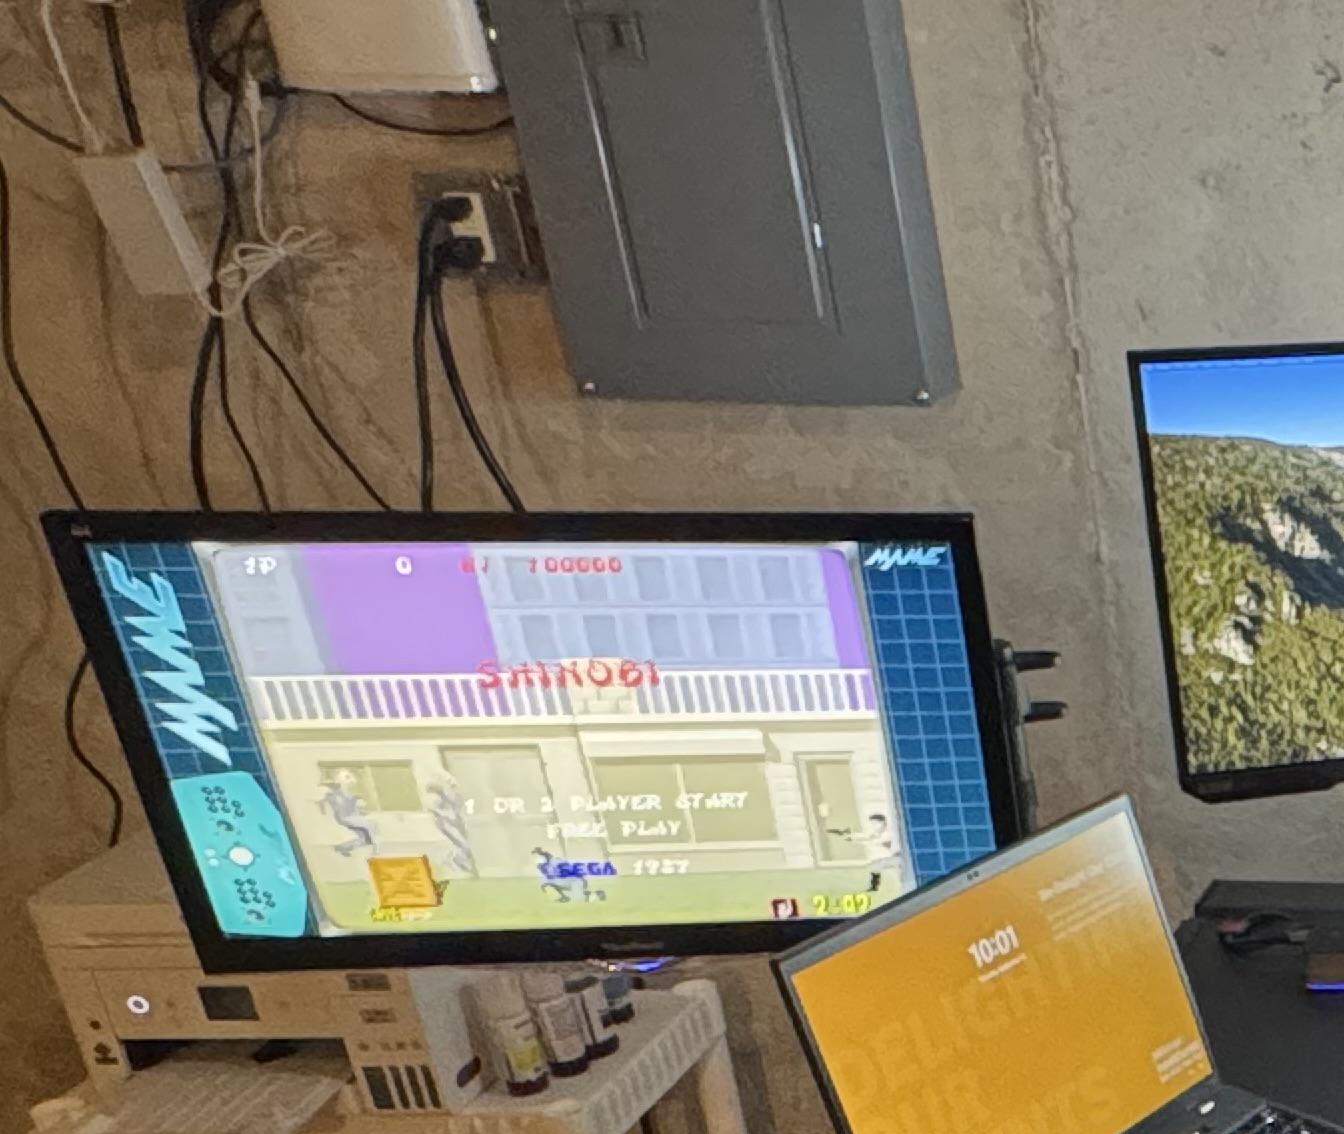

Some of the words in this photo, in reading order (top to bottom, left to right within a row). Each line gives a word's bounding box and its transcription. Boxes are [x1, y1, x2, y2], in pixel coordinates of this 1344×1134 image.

[476, 659, 661, 688] SHINOBI
[571, 793, 662, 812] PLAYER
[676, 791, 749, 810] START
[547, 821, 607, 839] FREE
[620, 820, 681, 837] PLAY
[967, 924, 1019, 968] 10:01
